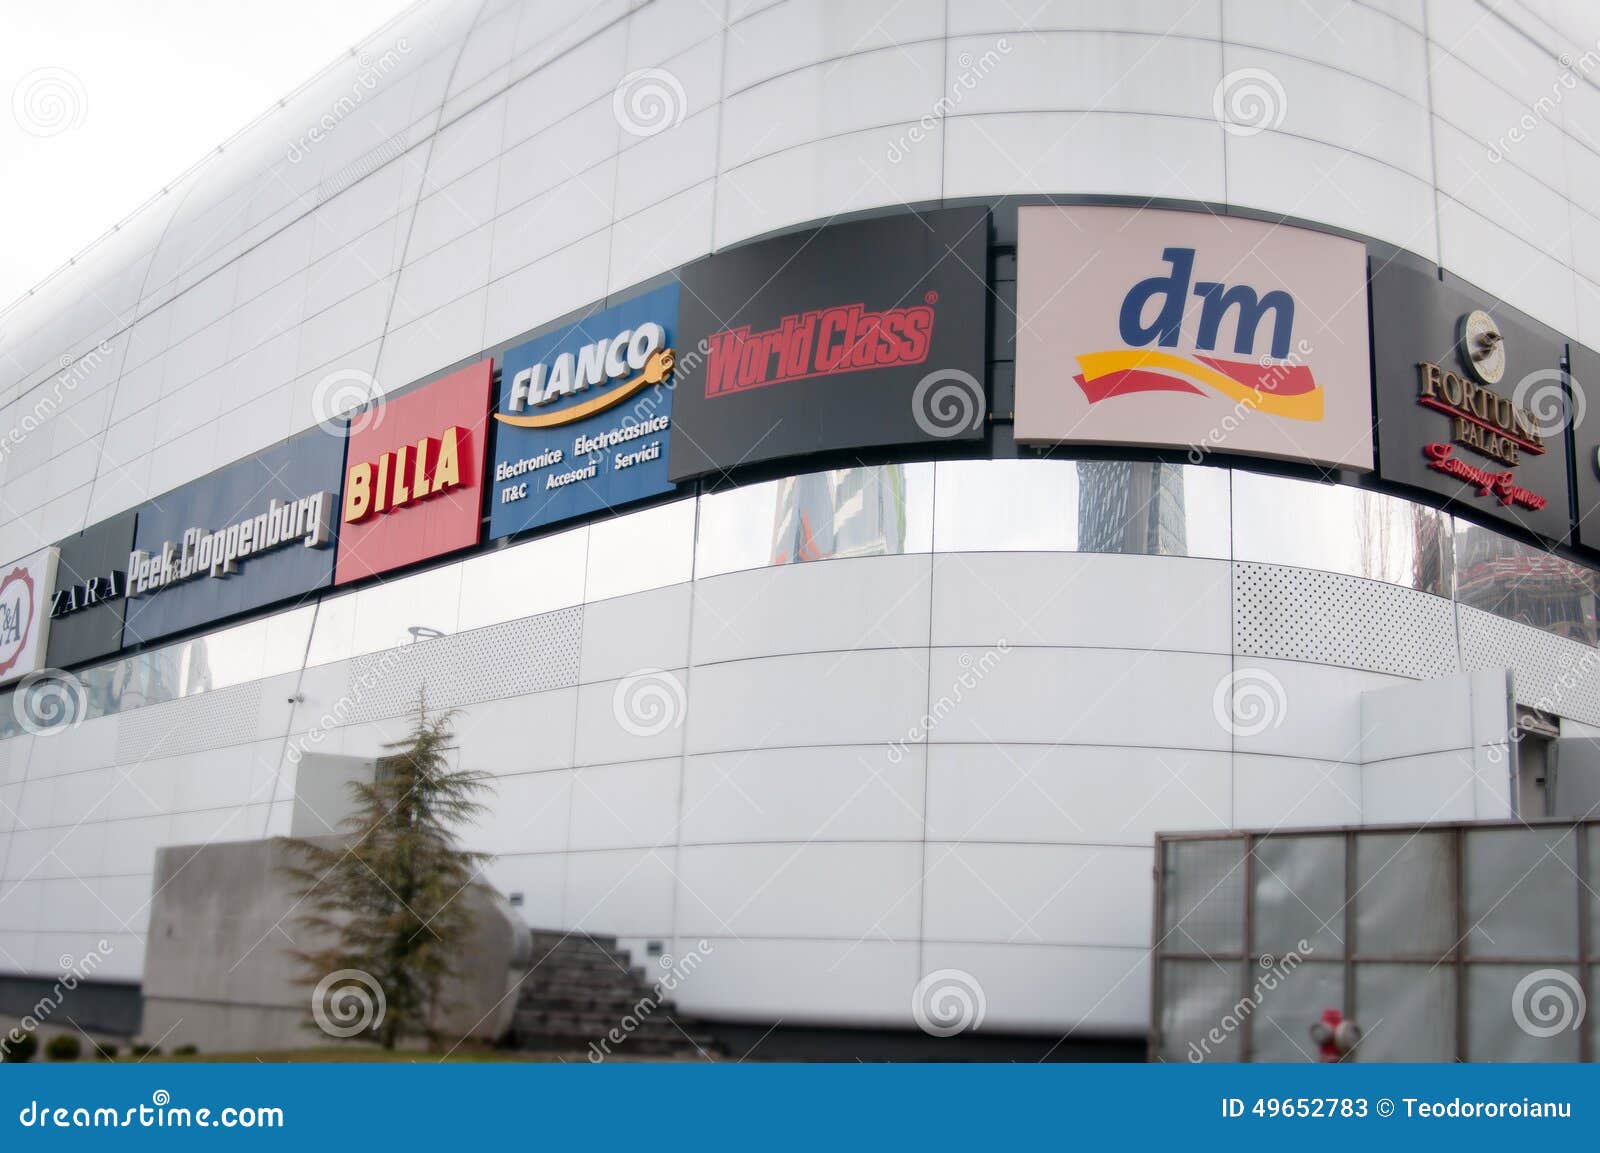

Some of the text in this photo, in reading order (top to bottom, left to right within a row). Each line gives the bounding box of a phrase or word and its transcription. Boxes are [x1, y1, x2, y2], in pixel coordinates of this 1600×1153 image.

[1118, 246, 1295, 359] dm
[508, 322, 666, 411] FLANCO
[705, 308, 824, 398] World
[1418, 361, 1545, 447] FORTUNA
[1455, 418, 1520, 467] PALACE
[344, 426, 468, 524] BILLA
[496, 413, 669, 482] Electronice Electrocasnice
[501, 440, 661, 504] IT&C Accesorii Servicii
[49, 569, 122, 618] ZARA
